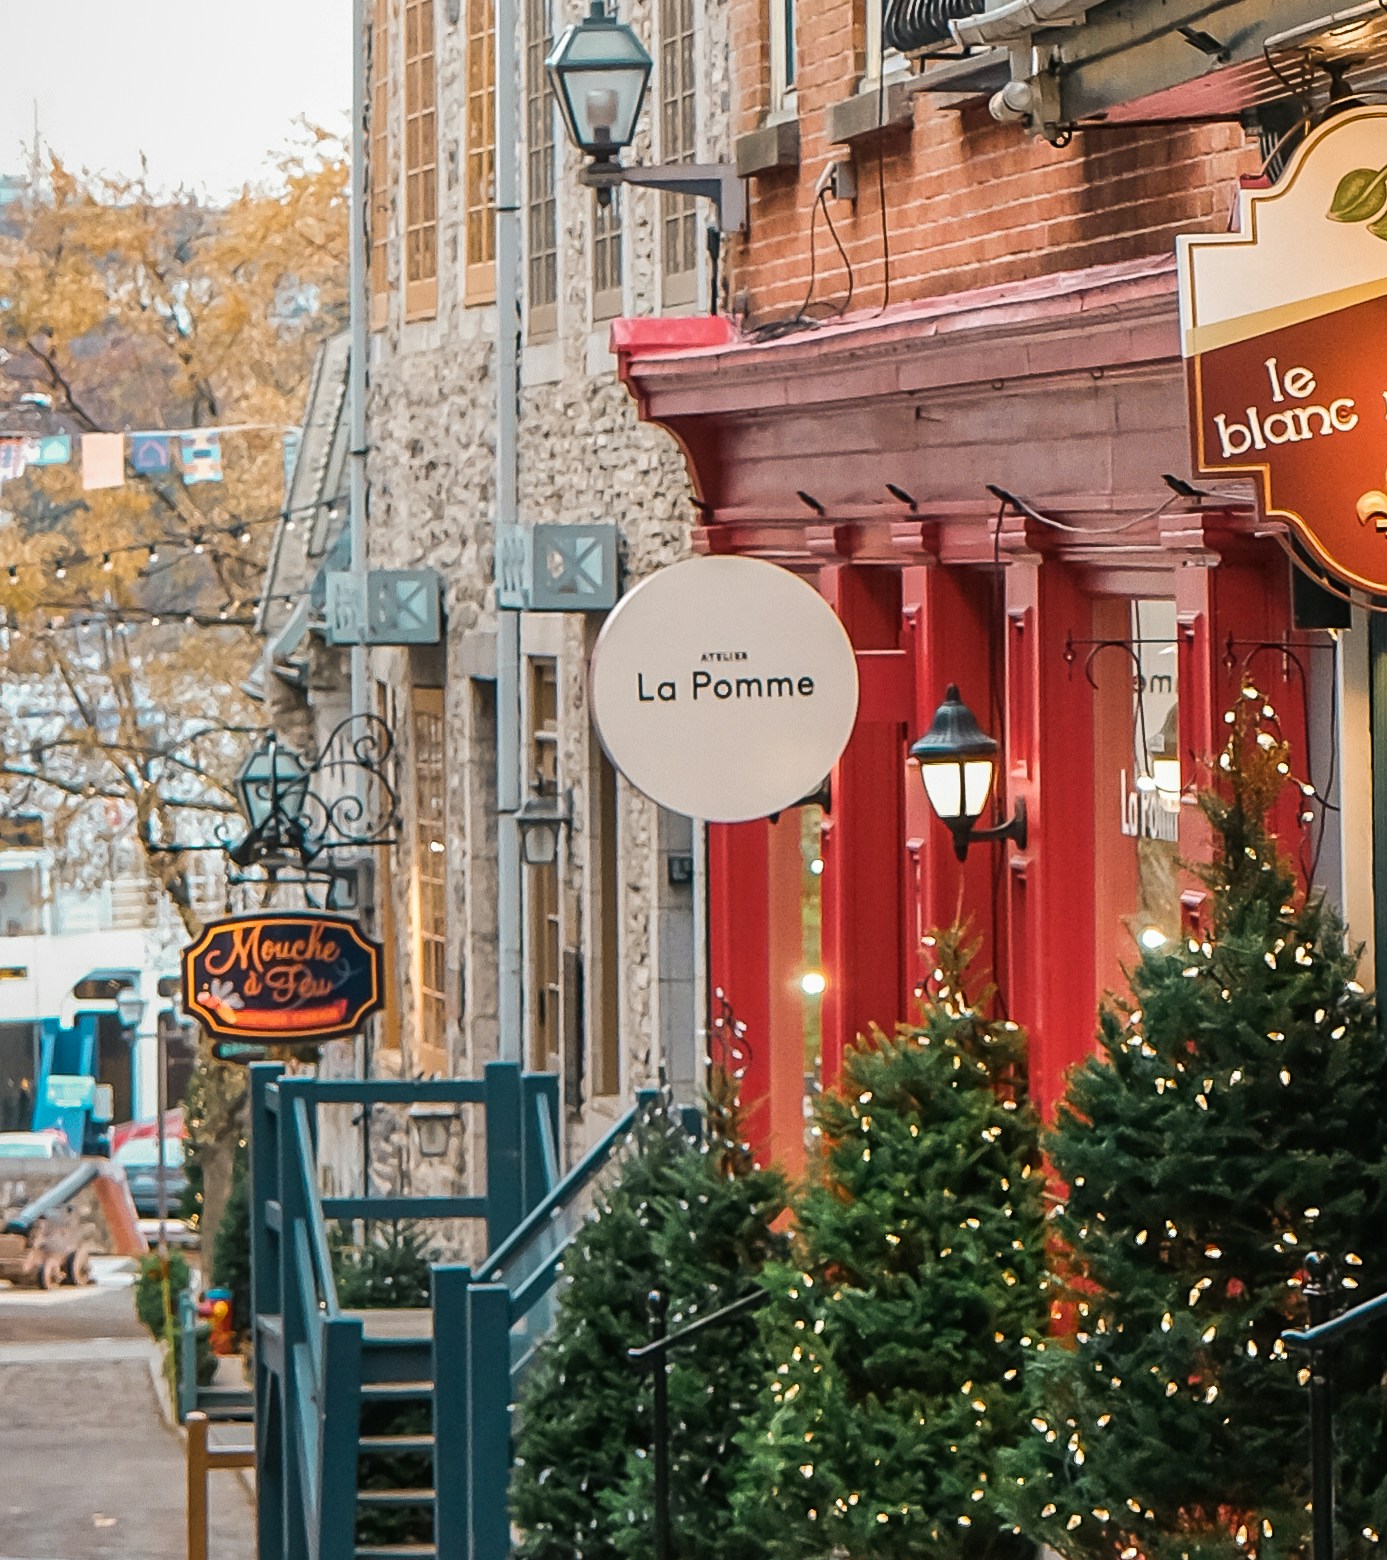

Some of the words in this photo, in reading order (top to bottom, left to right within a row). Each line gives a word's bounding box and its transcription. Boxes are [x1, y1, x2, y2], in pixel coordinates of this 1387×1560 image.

[1264, 357, 1317, 403] le
[1213, 396, 1359, 459] blanc
[700, 651, 749, 662] ATELIER
[637, 672, 677, 703] La
[692, 670, 815, 700] Pomme
[205, 921, 341, 976] Mouche
